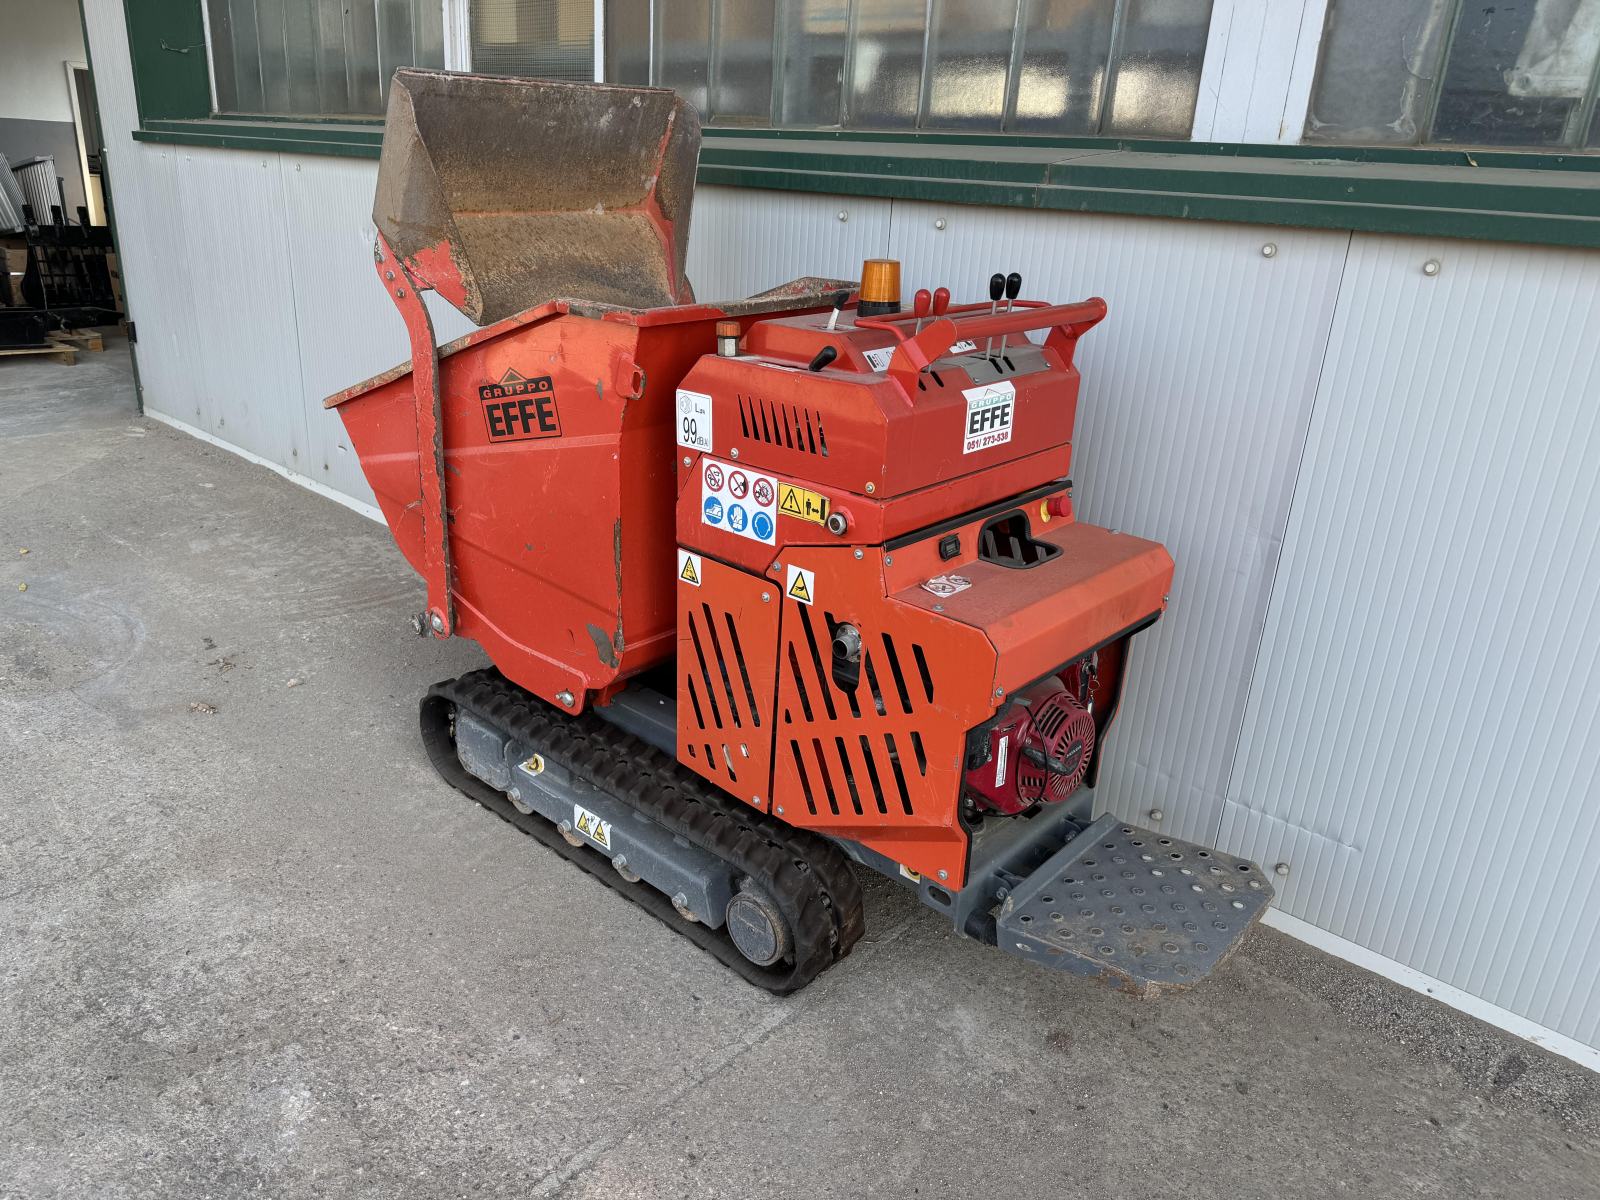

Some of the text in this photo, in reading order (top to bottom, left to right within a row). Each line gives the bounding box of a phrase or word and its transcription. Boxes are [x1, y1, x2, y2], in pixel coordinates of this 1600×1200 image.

[483, 381, 548, 398] GRUPPO
[971, 394, 1012, 408] GRUPPO
[486, 397, 556, 436] EFFE
[969, 403, 1010, 434] EFFE
[683, 417, 697, 444] 99
